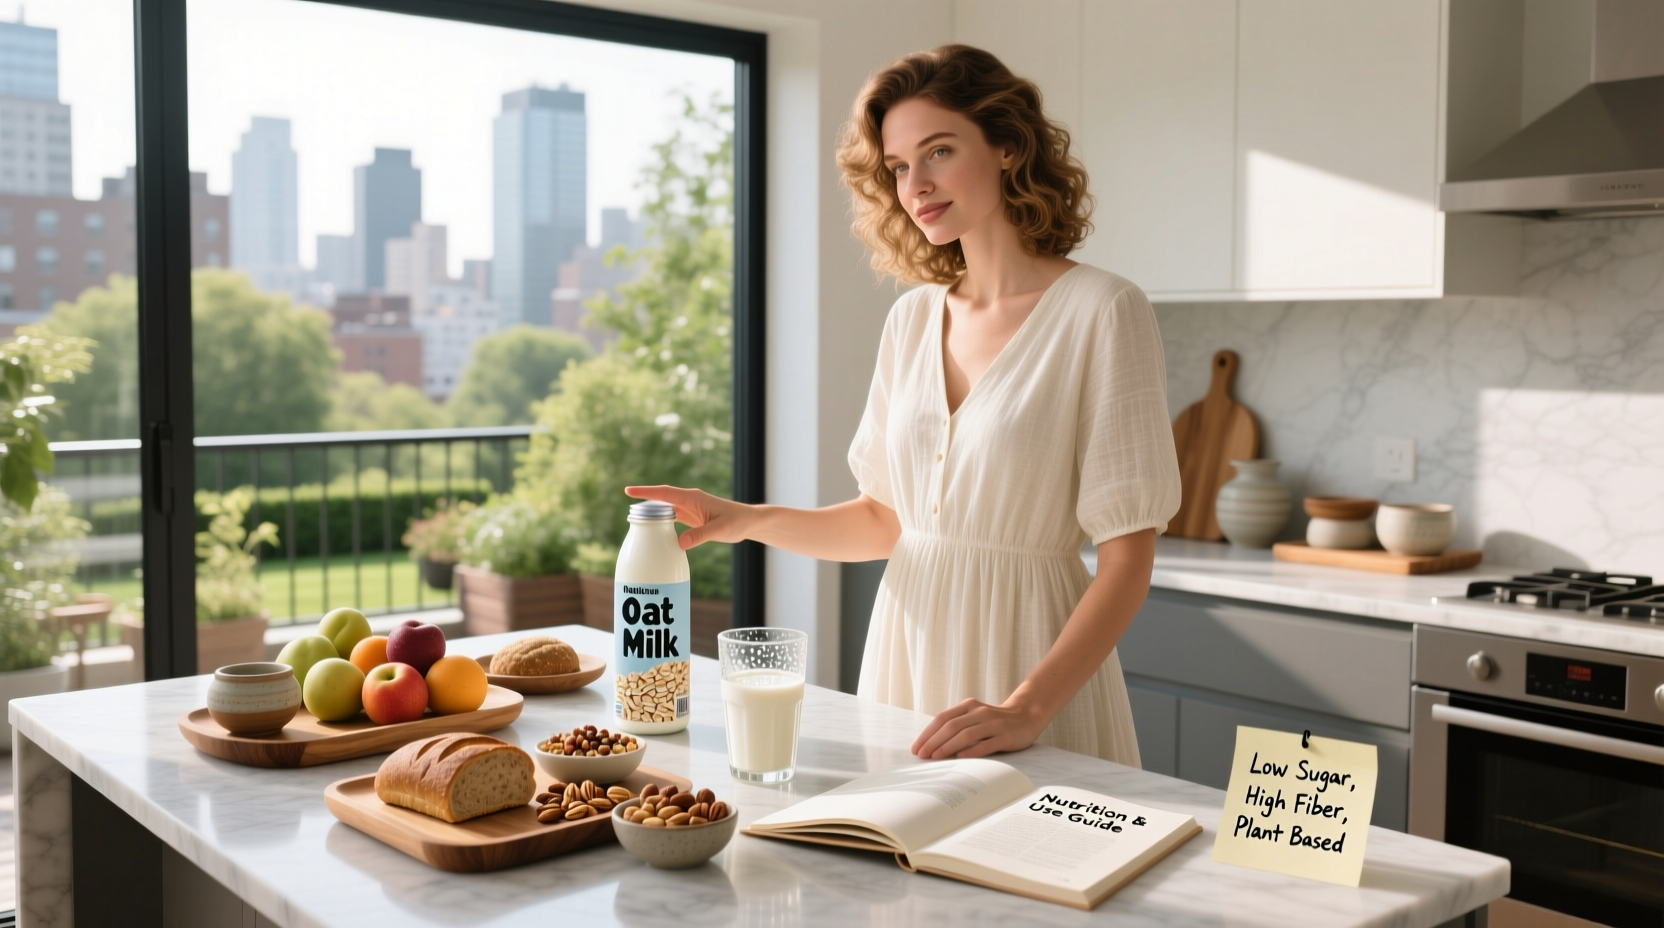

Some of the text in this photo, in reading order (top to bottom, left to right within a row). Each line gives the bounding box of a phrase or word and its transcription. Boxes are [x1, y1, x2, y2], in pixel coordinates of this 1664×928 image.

[622, 597, 674, 625] Oat
[623, 628, 680, 658] Milk
[1250, 752, 1355, 793] Low Sugar,
[1028, 802, 1123, 833] Use Guide
[1038, 793, 1147, 826] Nutrition &
[1245, 785, 1347, 825] High Fiber,
[1233, 815, 1346, 853] Plant Based
